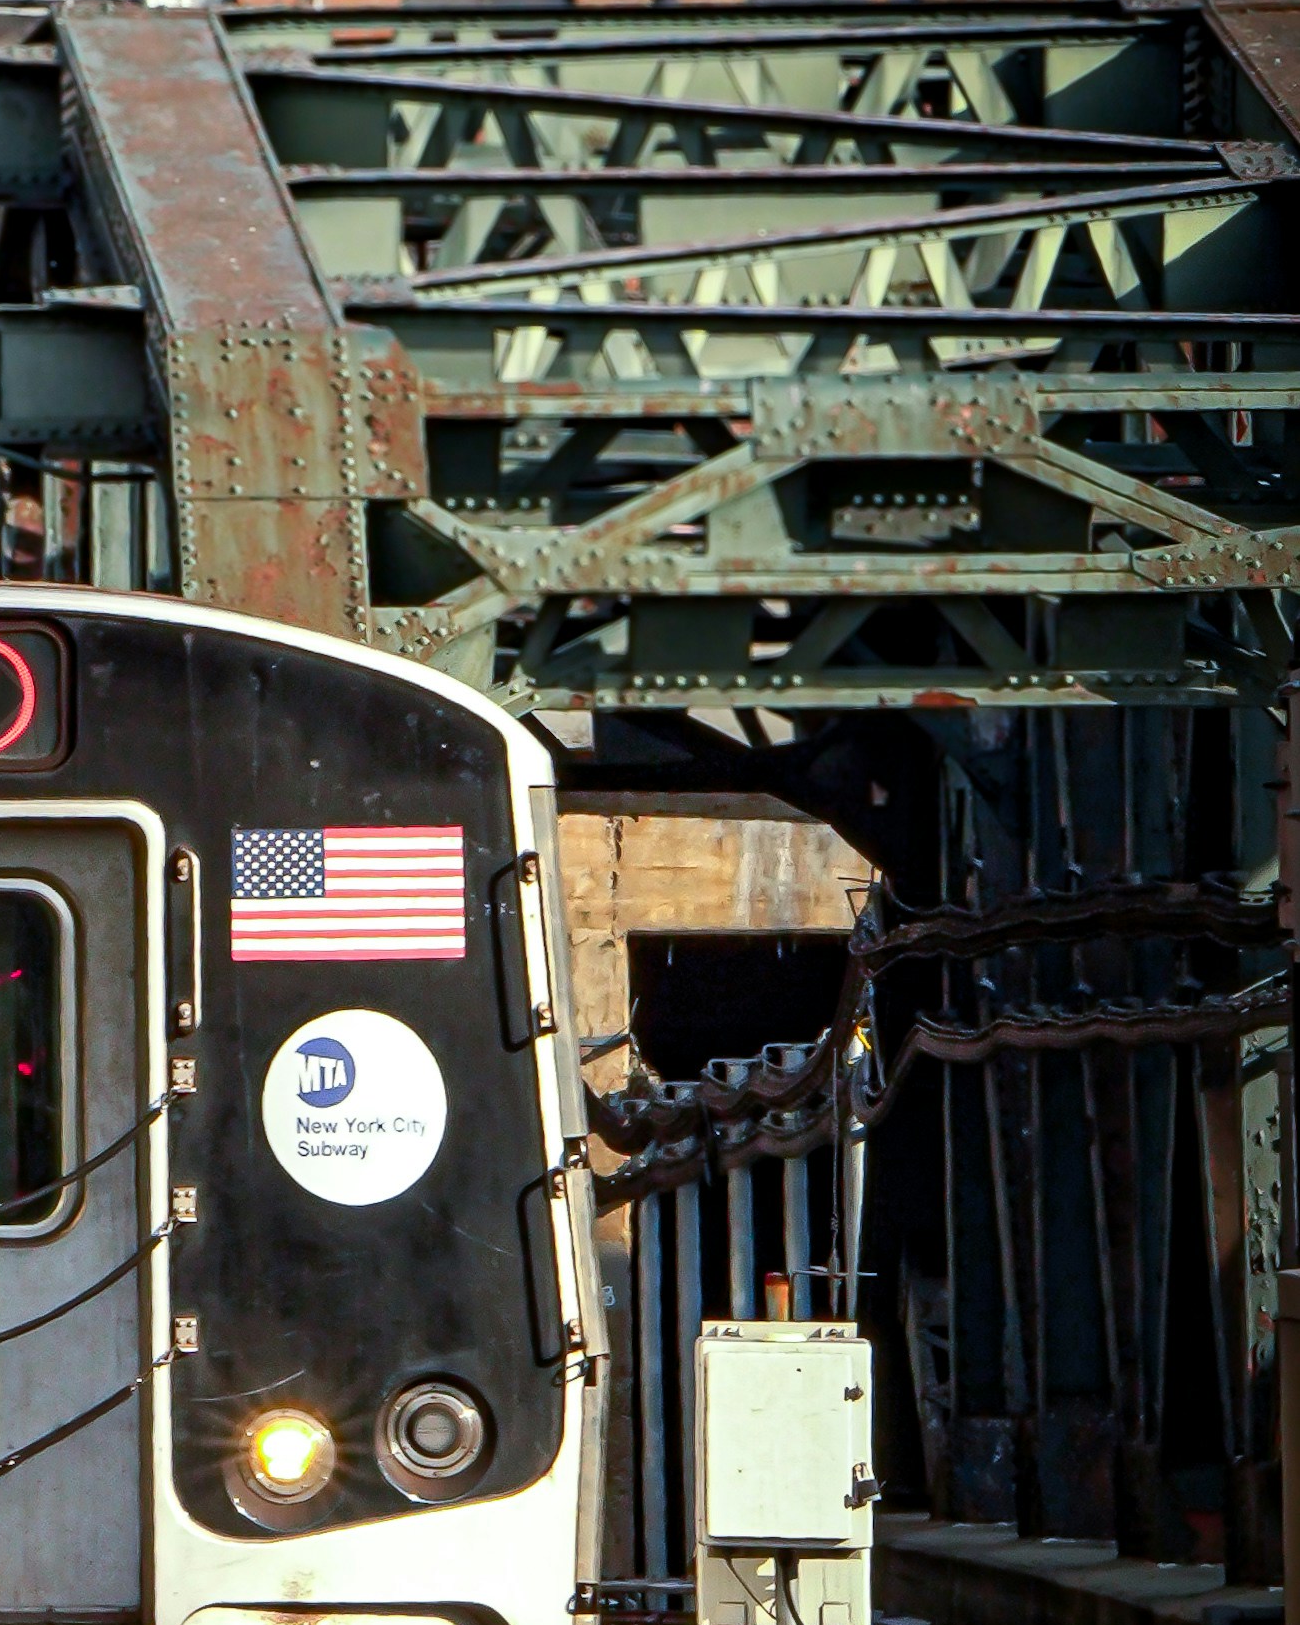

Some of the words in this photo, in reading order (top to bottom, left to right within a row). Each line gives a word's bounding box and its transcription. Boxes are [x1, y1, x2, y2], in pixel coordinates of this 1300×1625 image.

[298, 1054, 348, 1094] MTA
[296, 1116, 338, 1135] New
[345, 1116, 386, 1134] York
[392, 1116, 428, 1137] City
[297, 1139, 369, 1160] Subway
